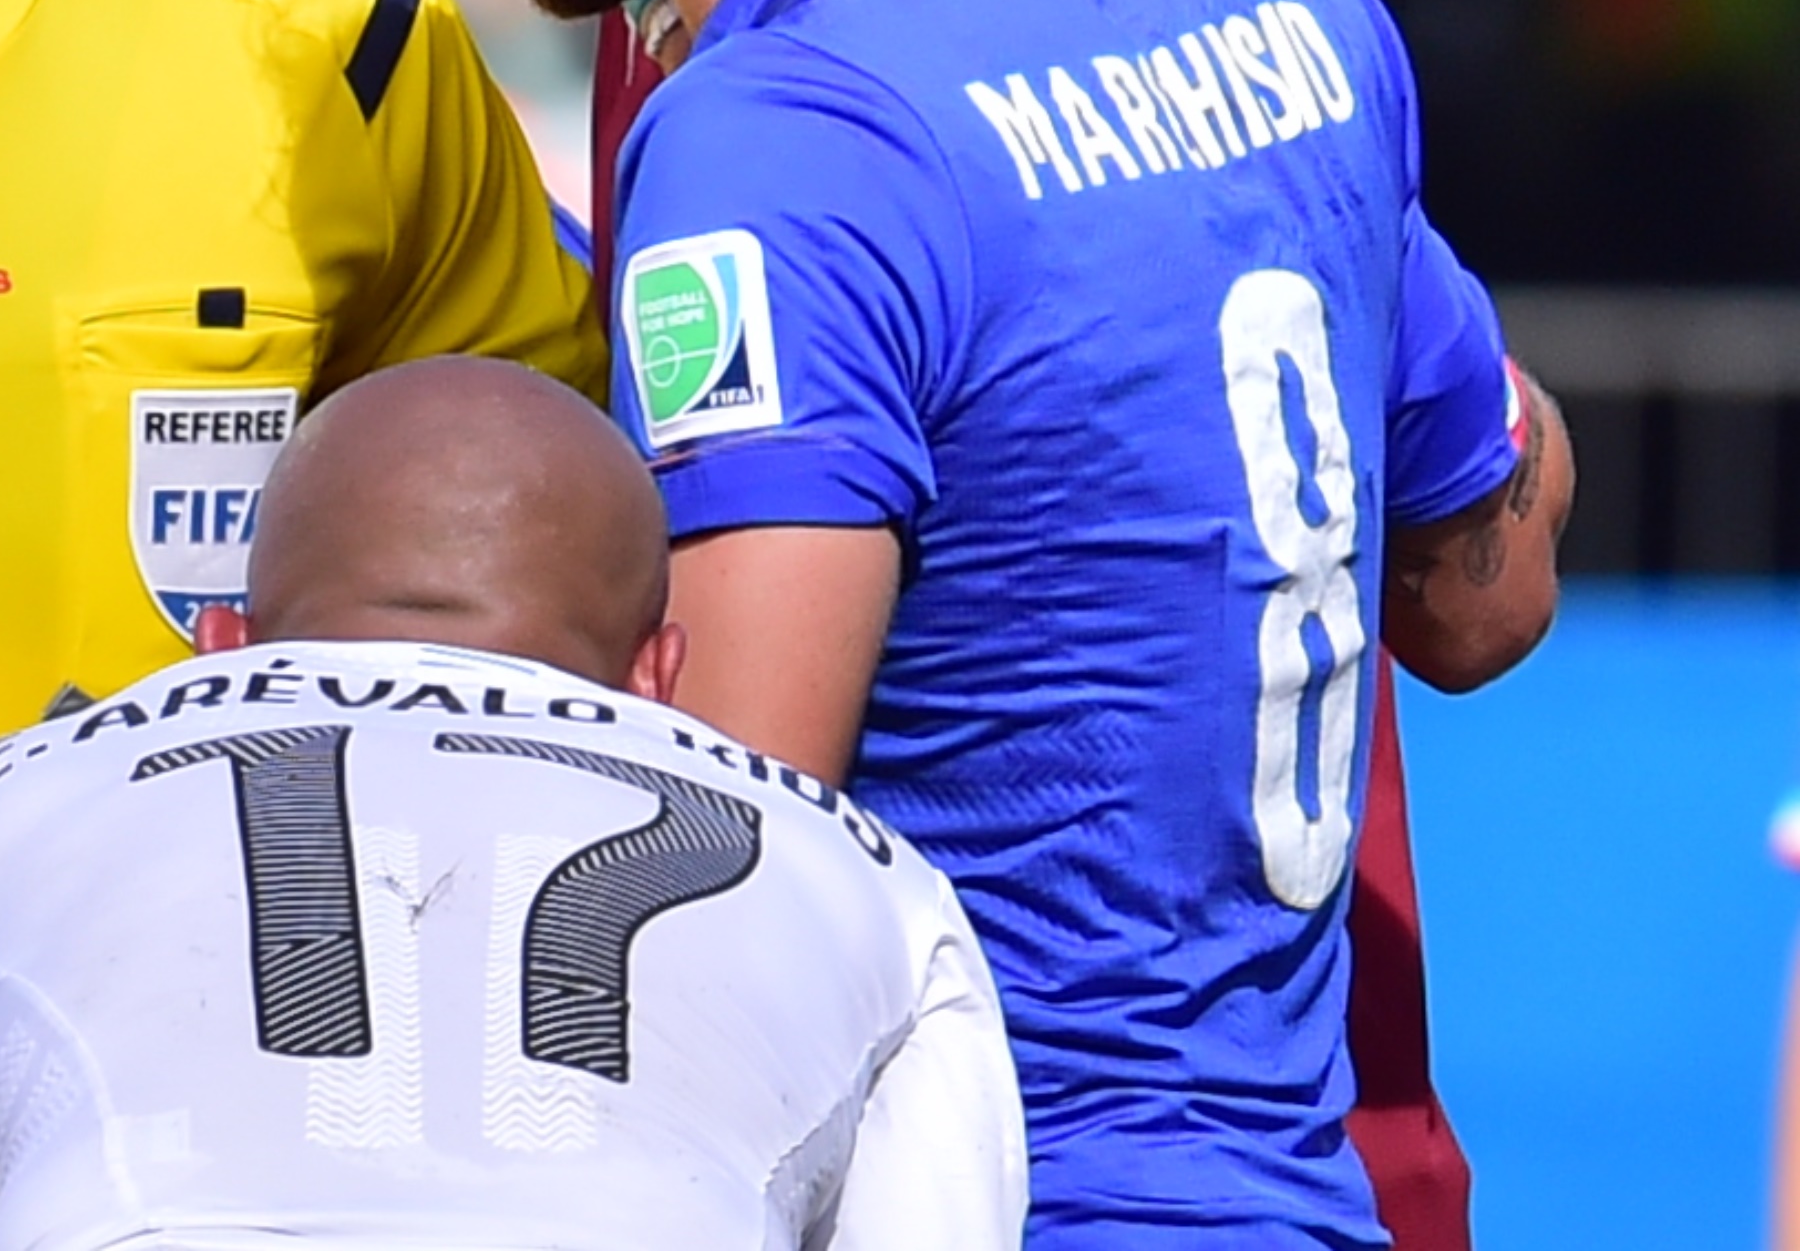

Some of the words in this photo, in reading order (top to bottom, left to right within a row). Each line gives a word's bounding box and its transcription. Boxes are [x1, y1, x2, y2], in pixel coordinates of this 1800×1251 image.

[963, 0, 1355, 200] MARHISIO
[144, 409, 287, 443] REFEREE
[710, 385, 752, 407] FIFA
[1218, 267, 1366, 910] 8
[71, 659, 616, 742] ARÉVALO
[129, 726, 763, 1084] 17
